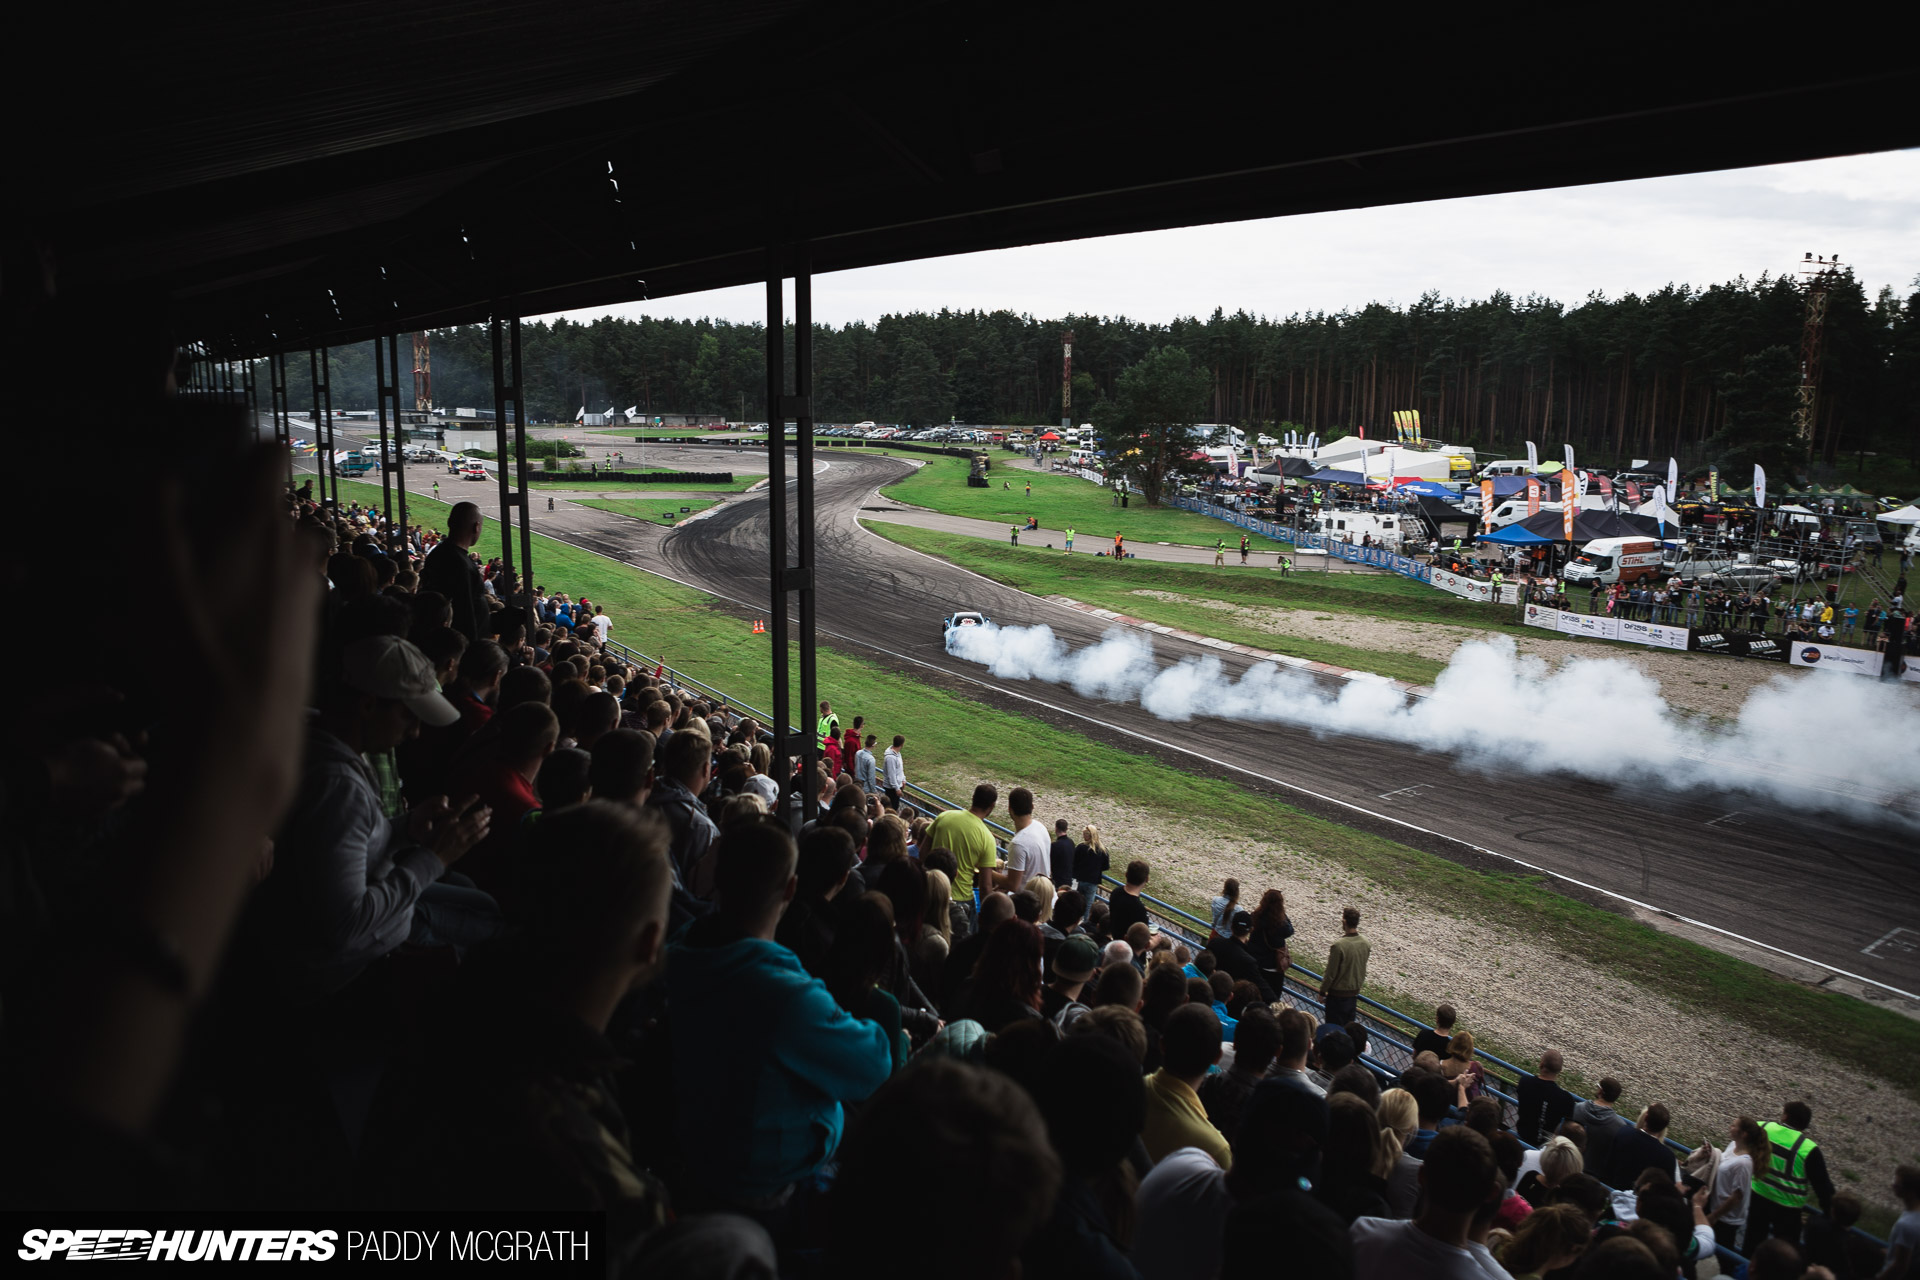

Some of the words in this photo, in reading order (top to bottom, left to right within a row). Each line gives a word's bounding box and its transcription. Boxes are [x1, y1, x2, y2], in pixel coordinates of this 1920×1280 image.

[1621, 556, 1645, 565] STIHL
[1697, 633, 1724, 643] RIGA
[1748, 639, 1776, 649] RIGA
